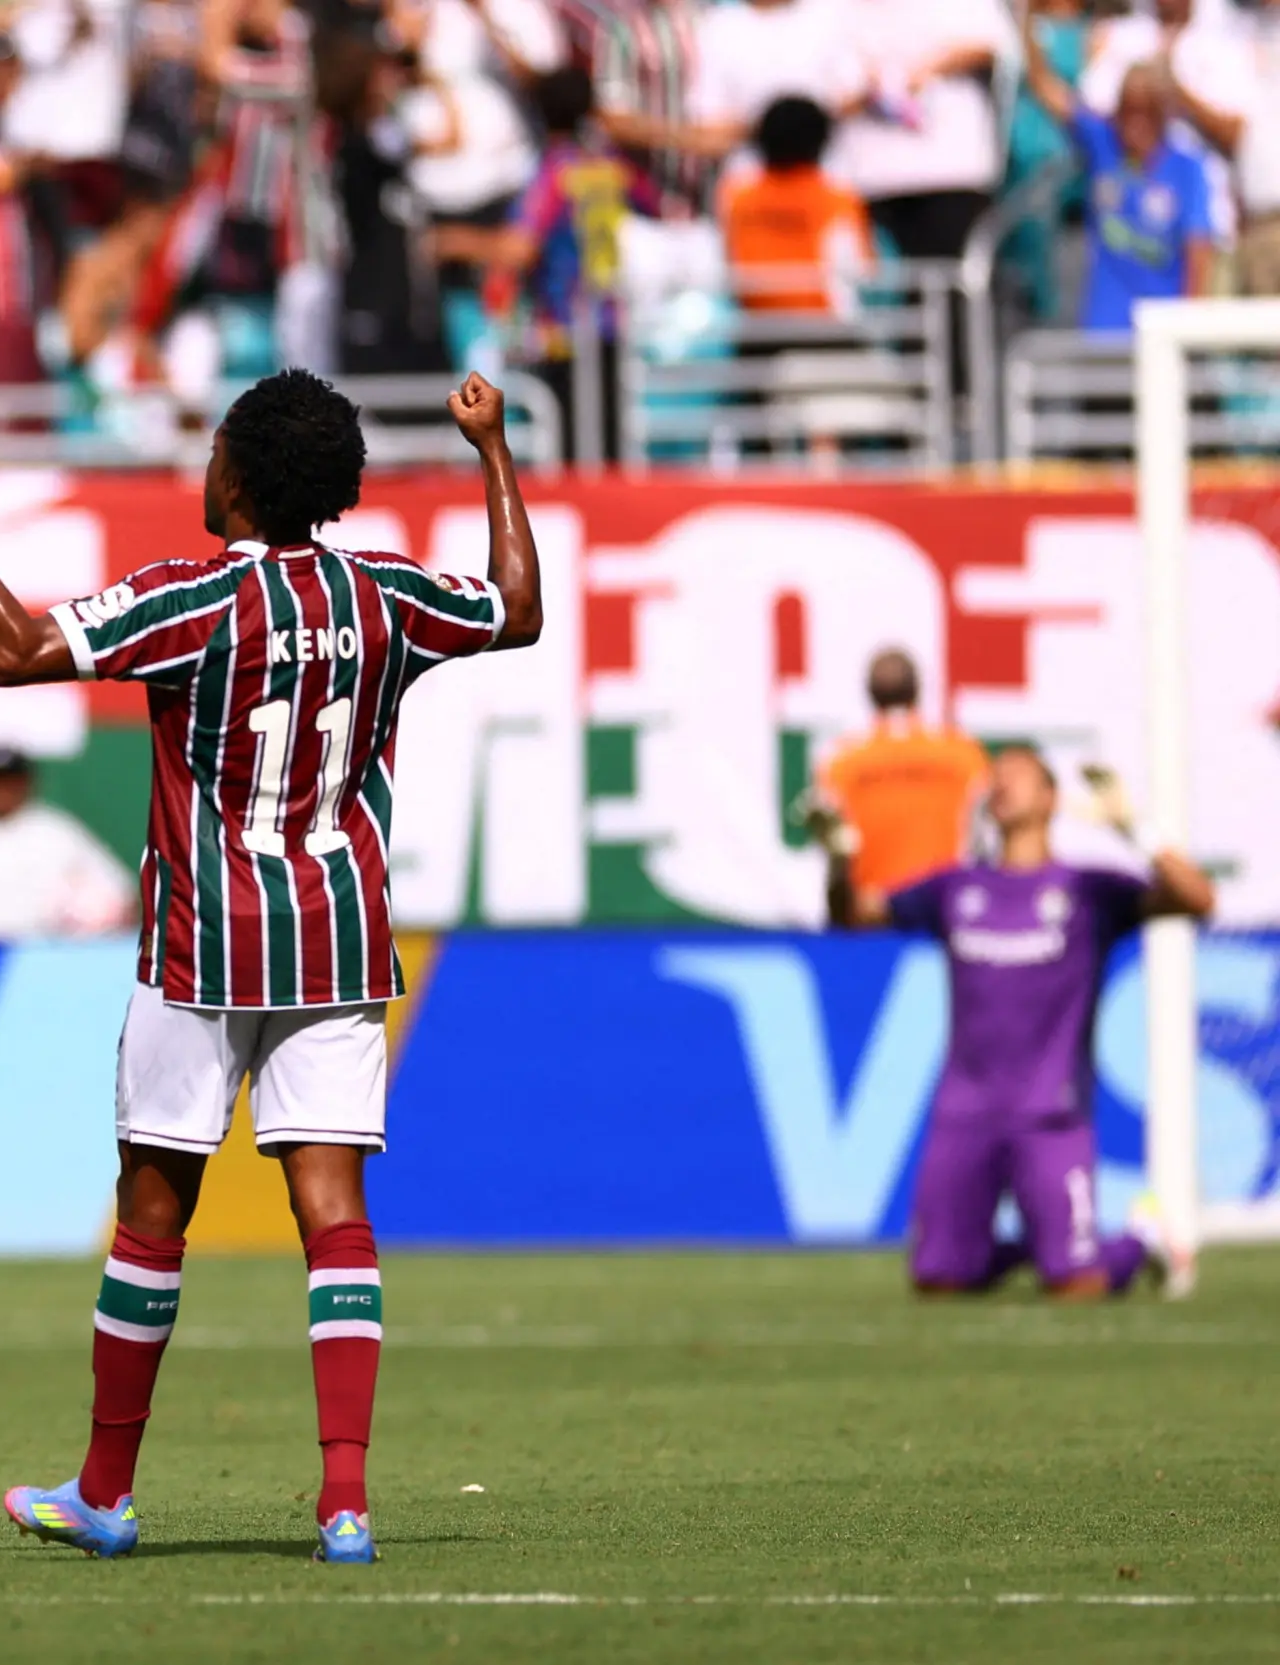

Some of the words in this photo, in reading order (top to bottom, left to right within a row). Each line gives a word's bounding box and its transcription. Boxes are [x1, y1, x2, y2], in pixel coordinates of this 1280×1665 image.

[271, 626, 357, 663] KENO
[240, 697, 354, 858] 11
[332, 1294, 372, 1306] FFC
